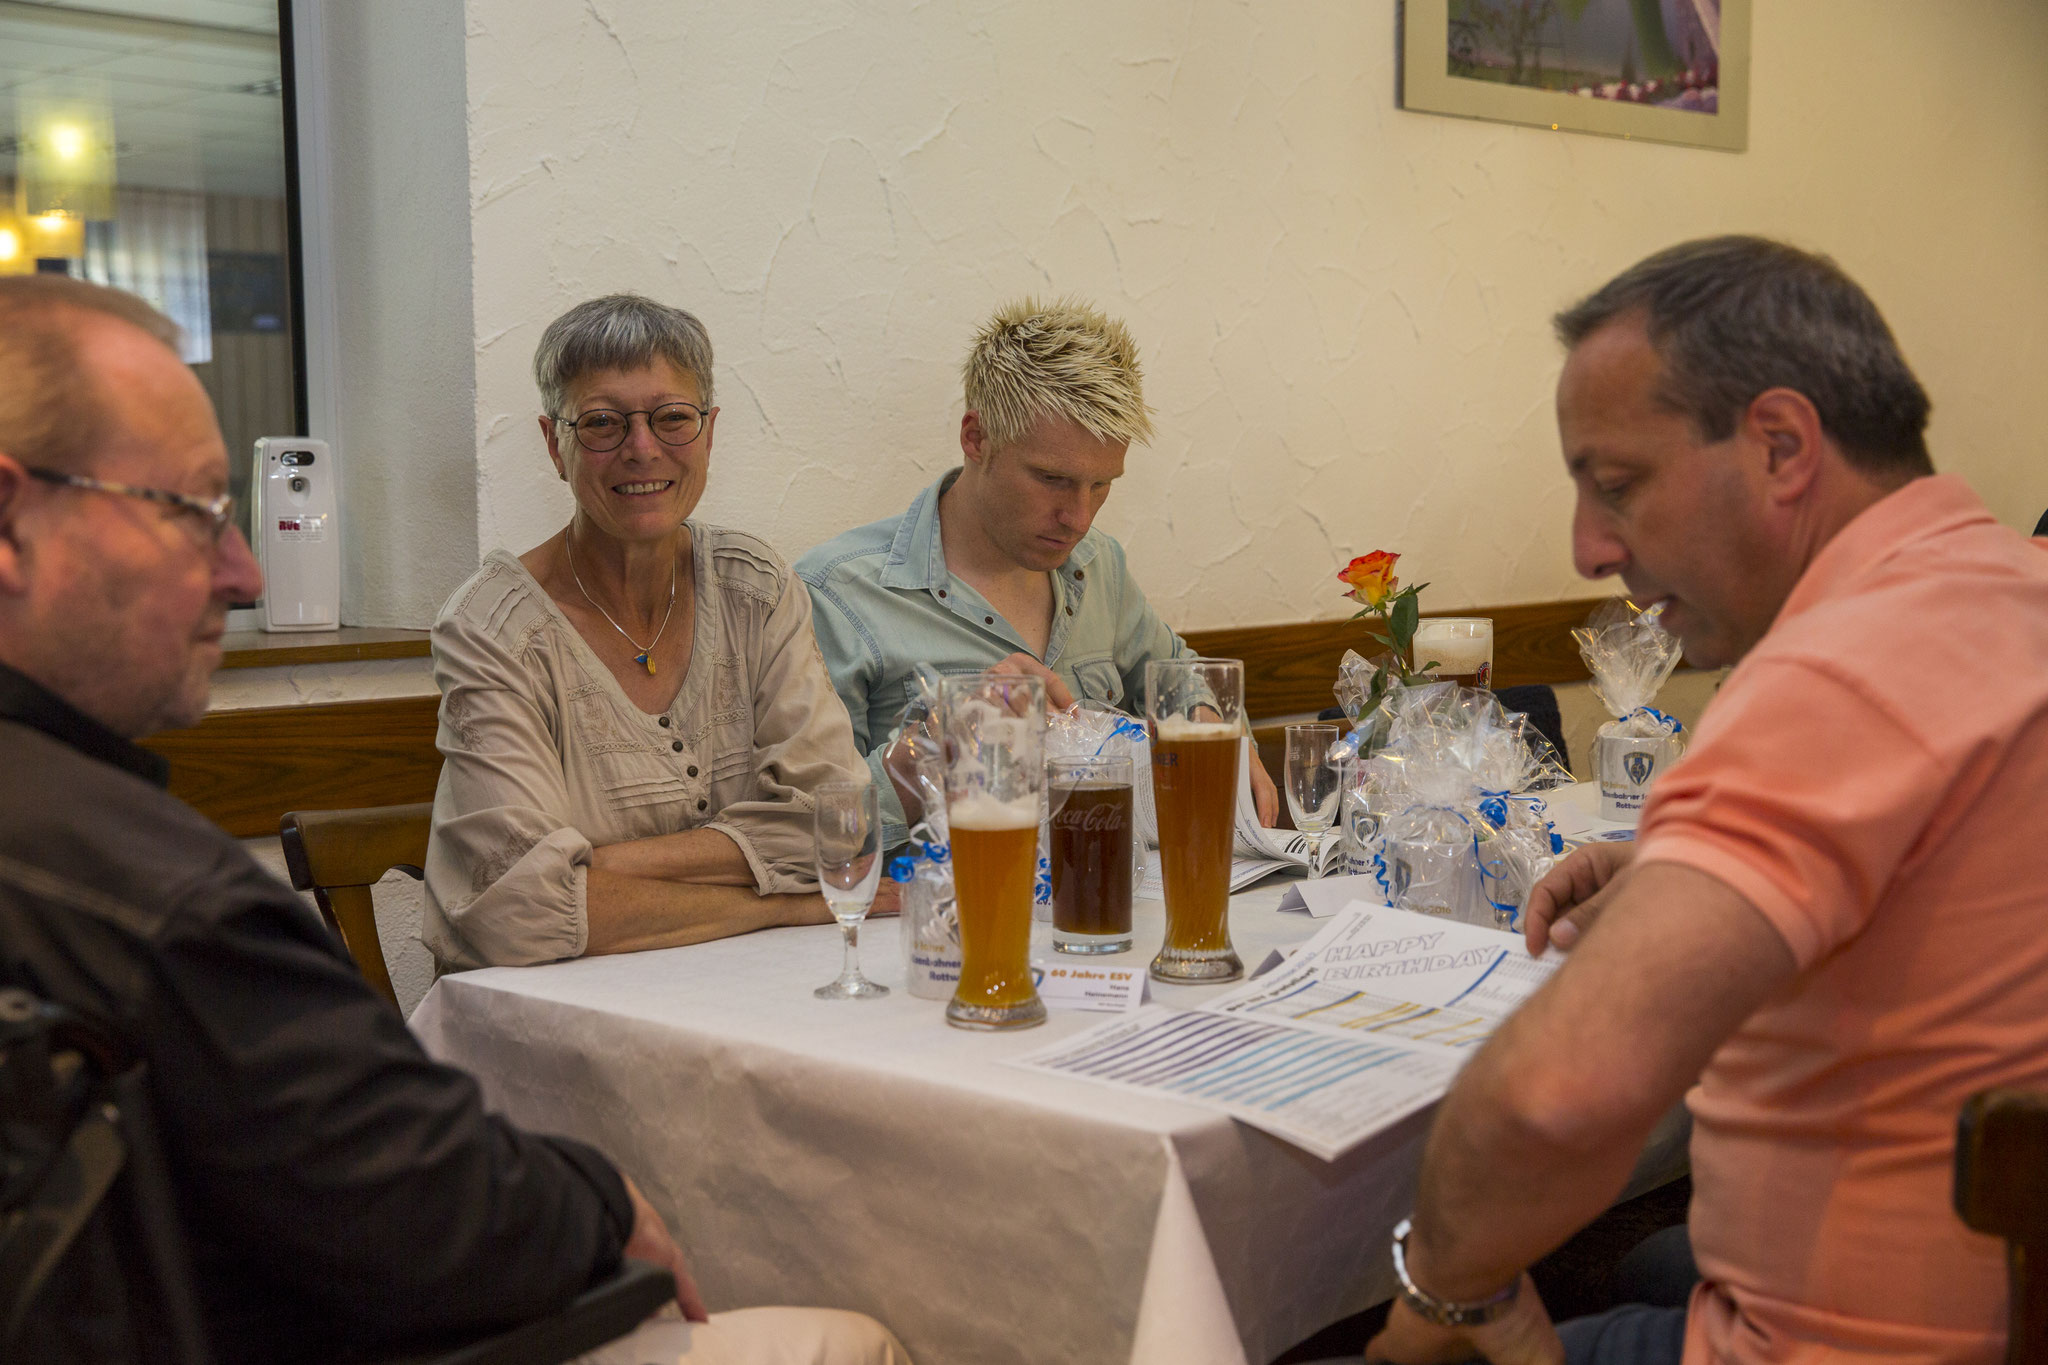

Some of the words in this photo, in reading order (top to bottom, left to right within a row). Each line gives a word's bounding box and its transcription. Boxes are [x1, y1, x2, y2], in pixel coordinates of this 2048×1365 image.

[1322, 945, 1500, 981] BIRTHDAY
[1324, 931, 1446, 963] HAPPY
[1050, 968, 1068, 978] 60
[1070, 969, 1106, 980] Jahre
[1109, 971, 1133, 981] ESV
